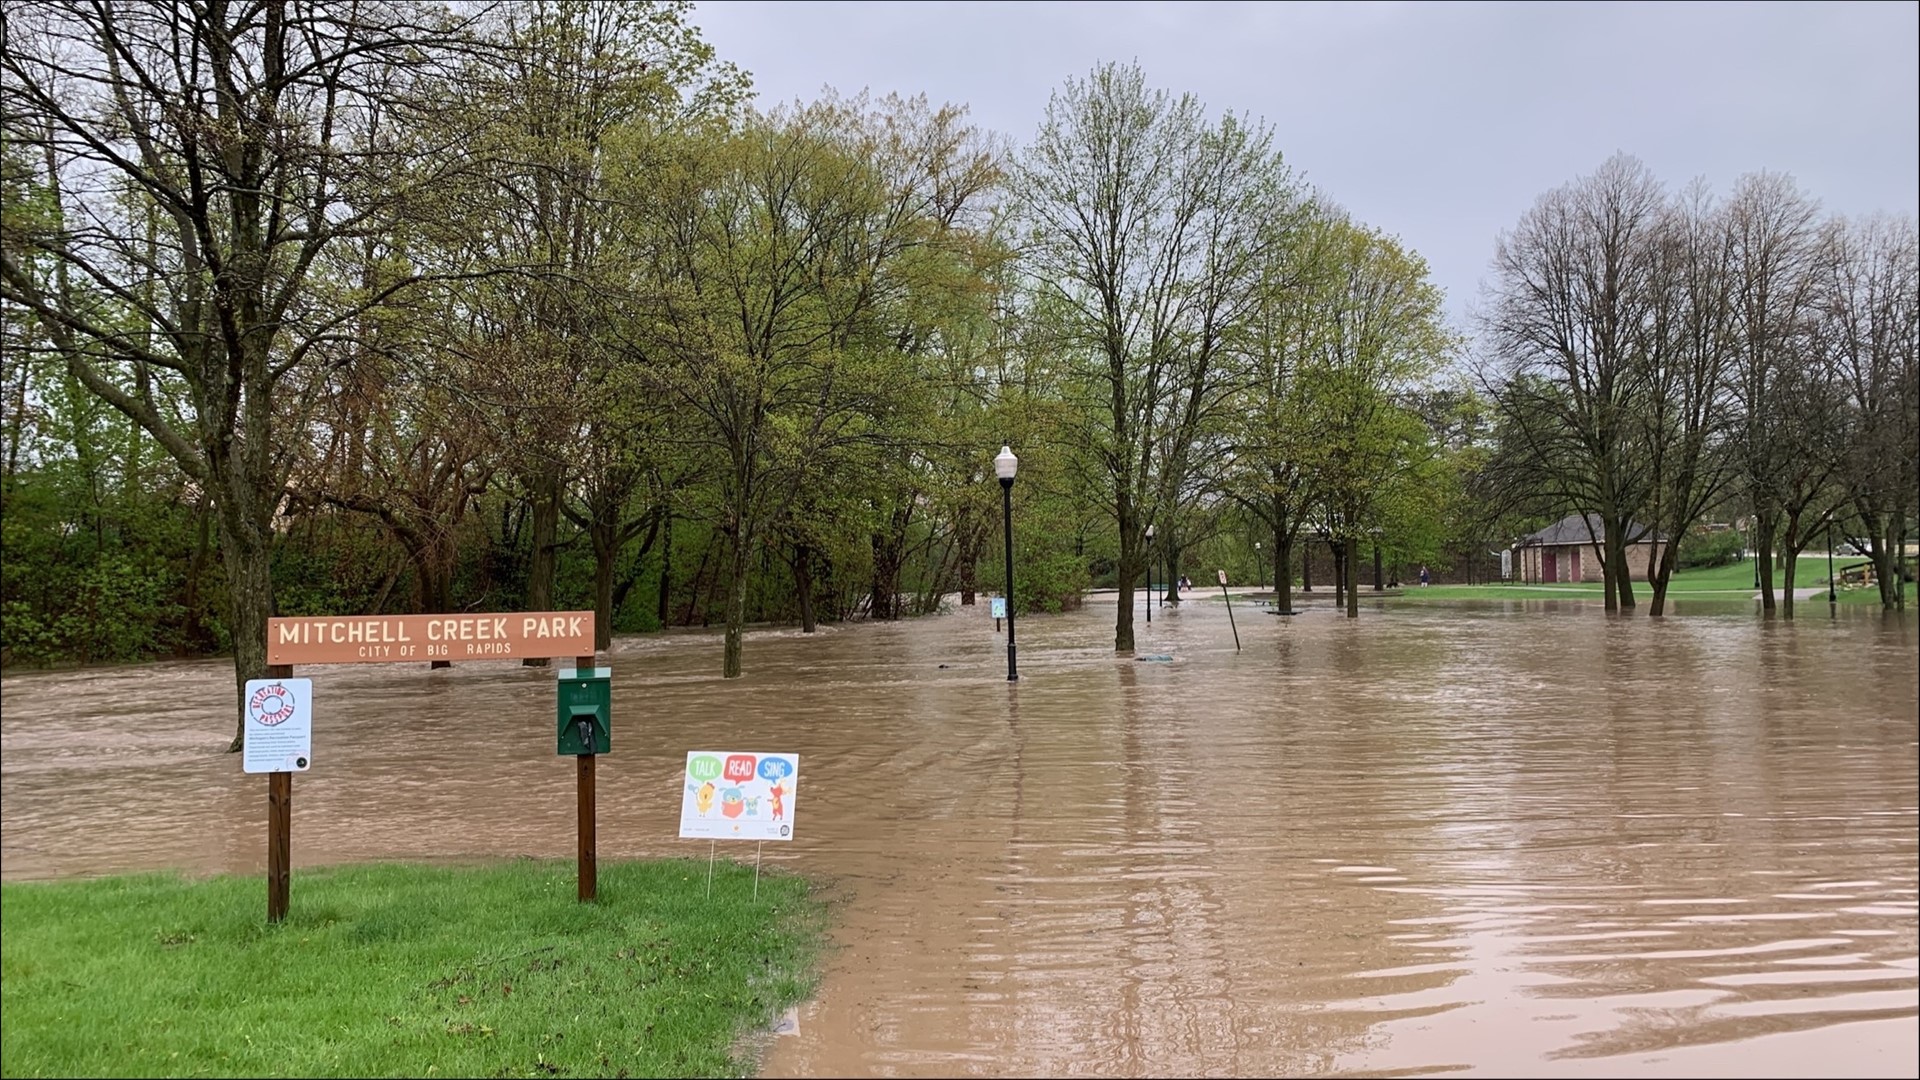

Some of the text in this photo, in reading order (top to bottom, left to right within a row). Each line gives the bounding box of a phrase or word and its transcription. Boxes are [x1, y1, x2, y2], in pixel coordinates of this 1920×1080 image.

[279, 616, 583, 645] MITCHELL CREEK PARK
[359, 642, 511, 658] CITY OF BIG RAPIDS
[252, 686, 286, 709] RECREATION
[259, 704, 292, 724] PASSPORT
[695, 760, 716, 777] TALK
[729, 760, 752, 777] READ
[764, 760, 785, 777] SING
